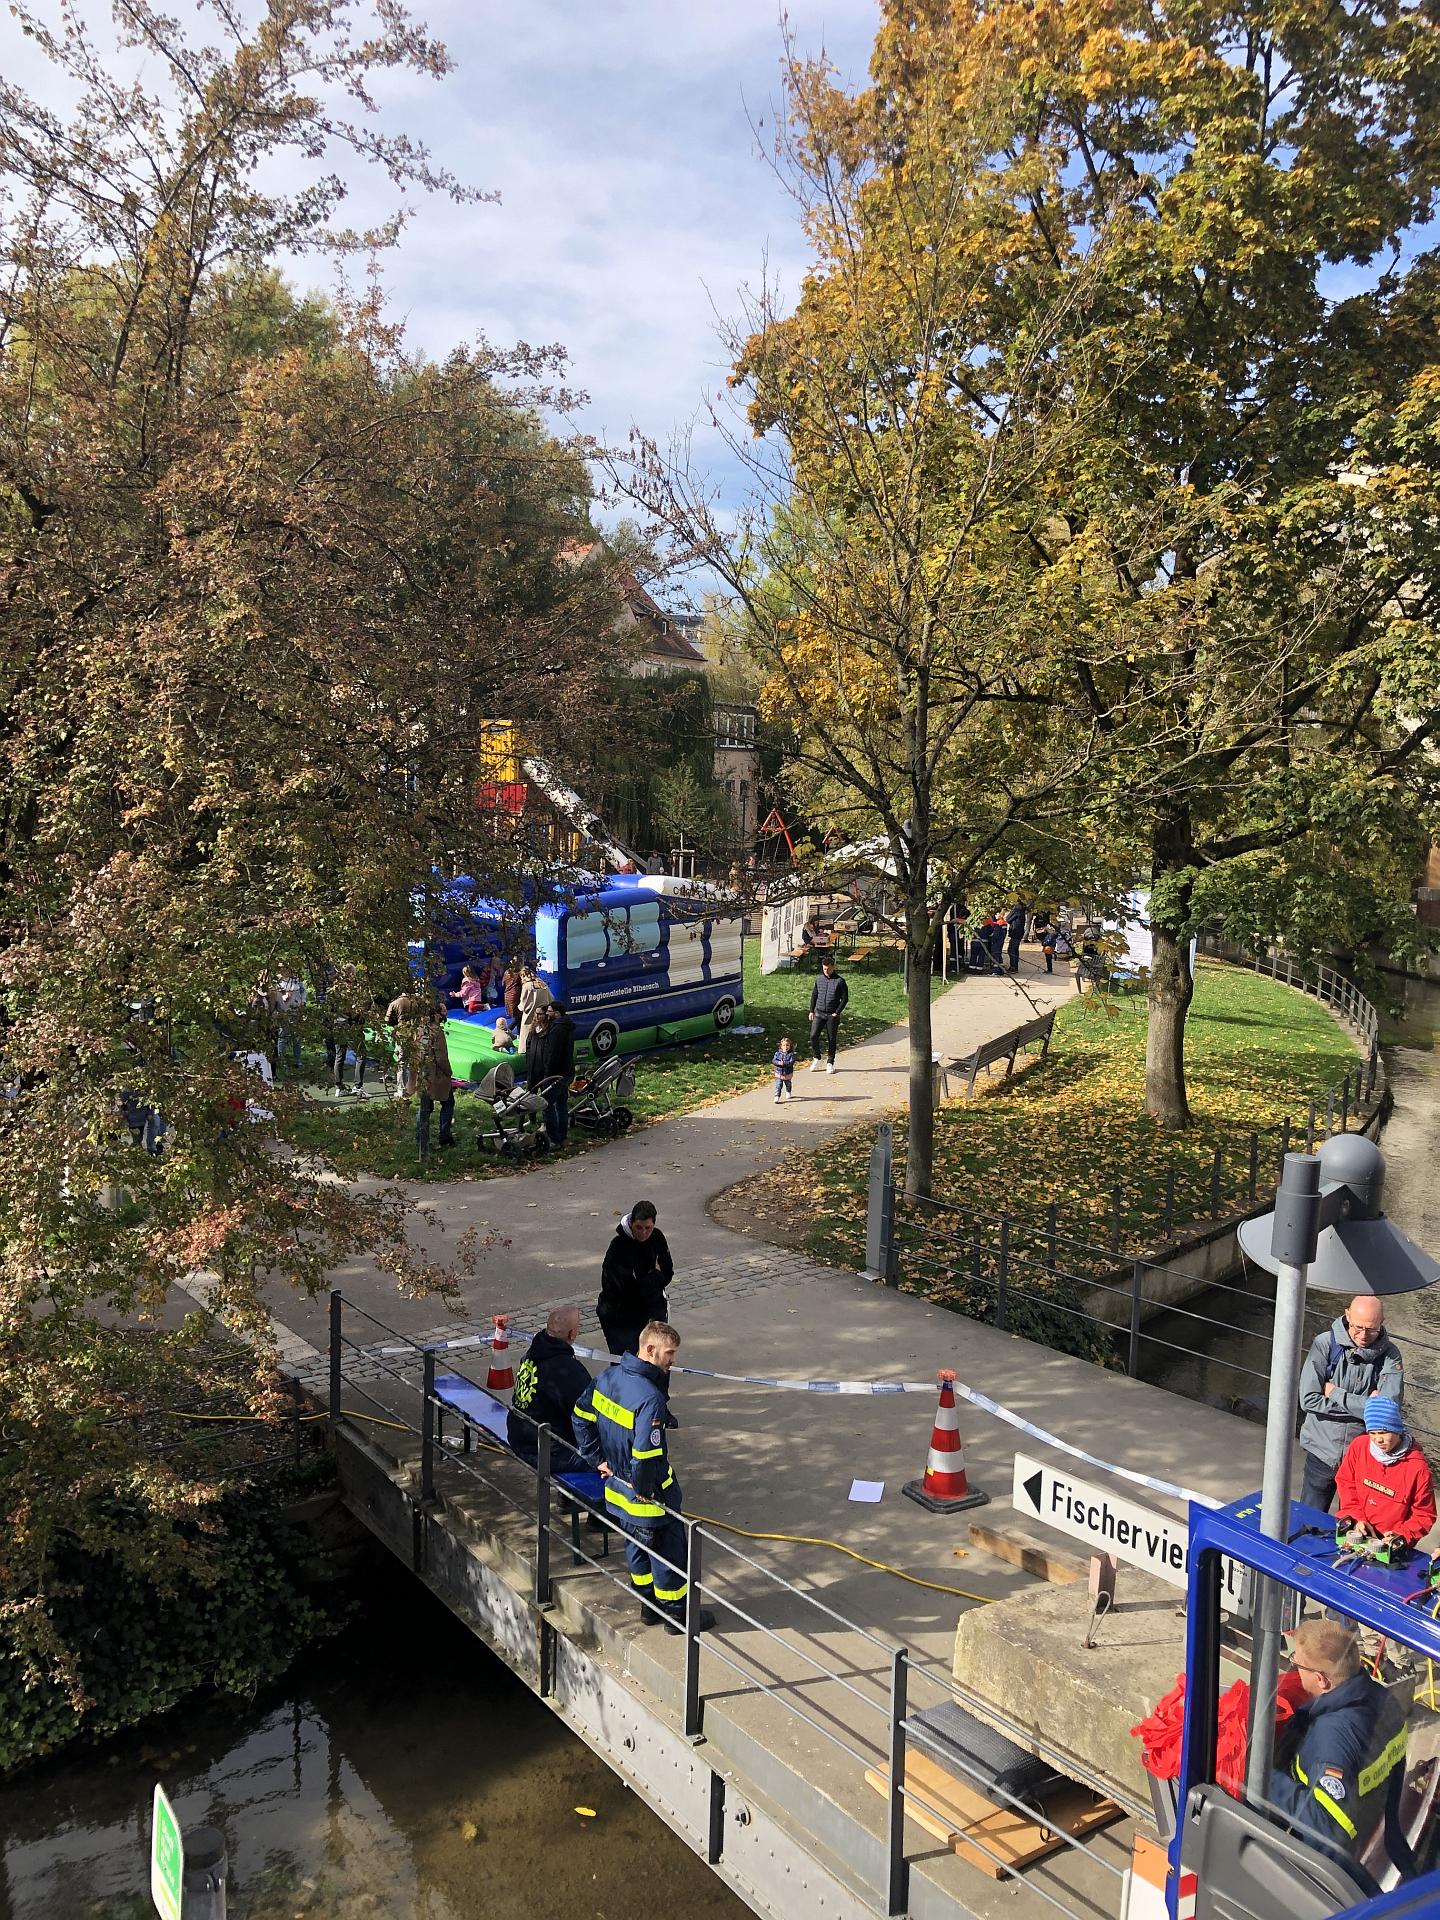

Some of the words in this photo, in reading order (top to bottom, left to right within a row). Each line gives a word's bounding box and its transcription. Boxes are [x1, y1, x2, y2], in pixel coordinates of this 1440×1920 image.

[571, 995, 587, 1004] THW
[589, 987, 632, 1001] Regionalstelle
[633, 982, 660, 992] Biberach
[1052, 1480, 1235, 1596] Fischerviel
